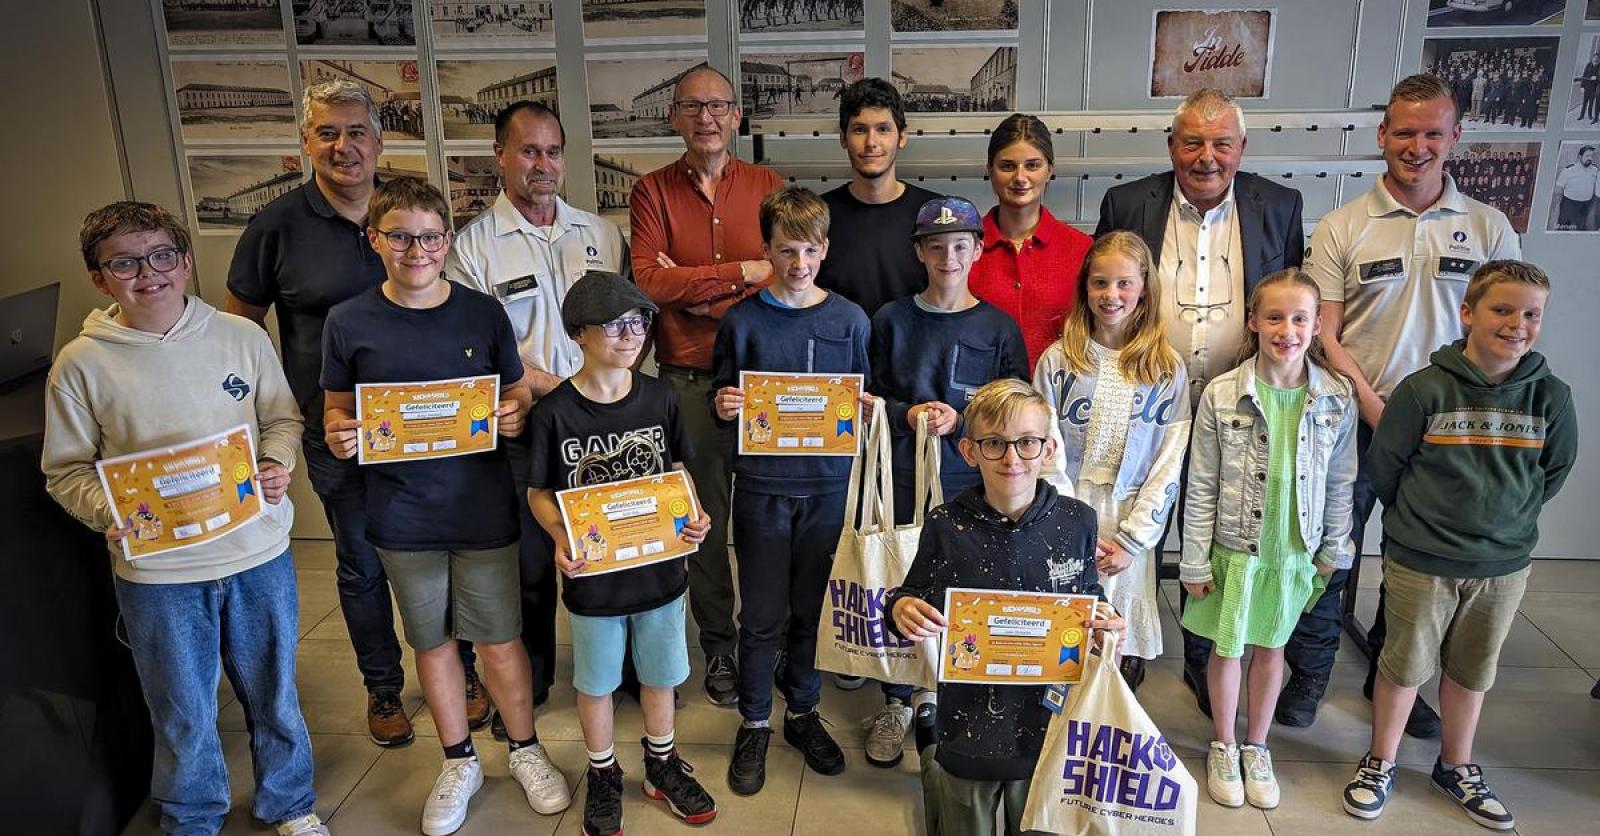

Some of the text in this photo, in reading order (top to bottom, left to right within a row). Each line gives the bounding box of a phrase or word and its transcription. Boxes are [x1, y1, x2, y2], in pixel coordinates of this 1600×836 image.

[1440, 420, 1475, 430] JACK
[1480, 420, 1493, 430] &
[1067, 719, 1156, 771] HACK
[1063, 759, 1181, 811] SHIELD
[1060, 797, 1175, 826] FUTURE CYBER HEROES
